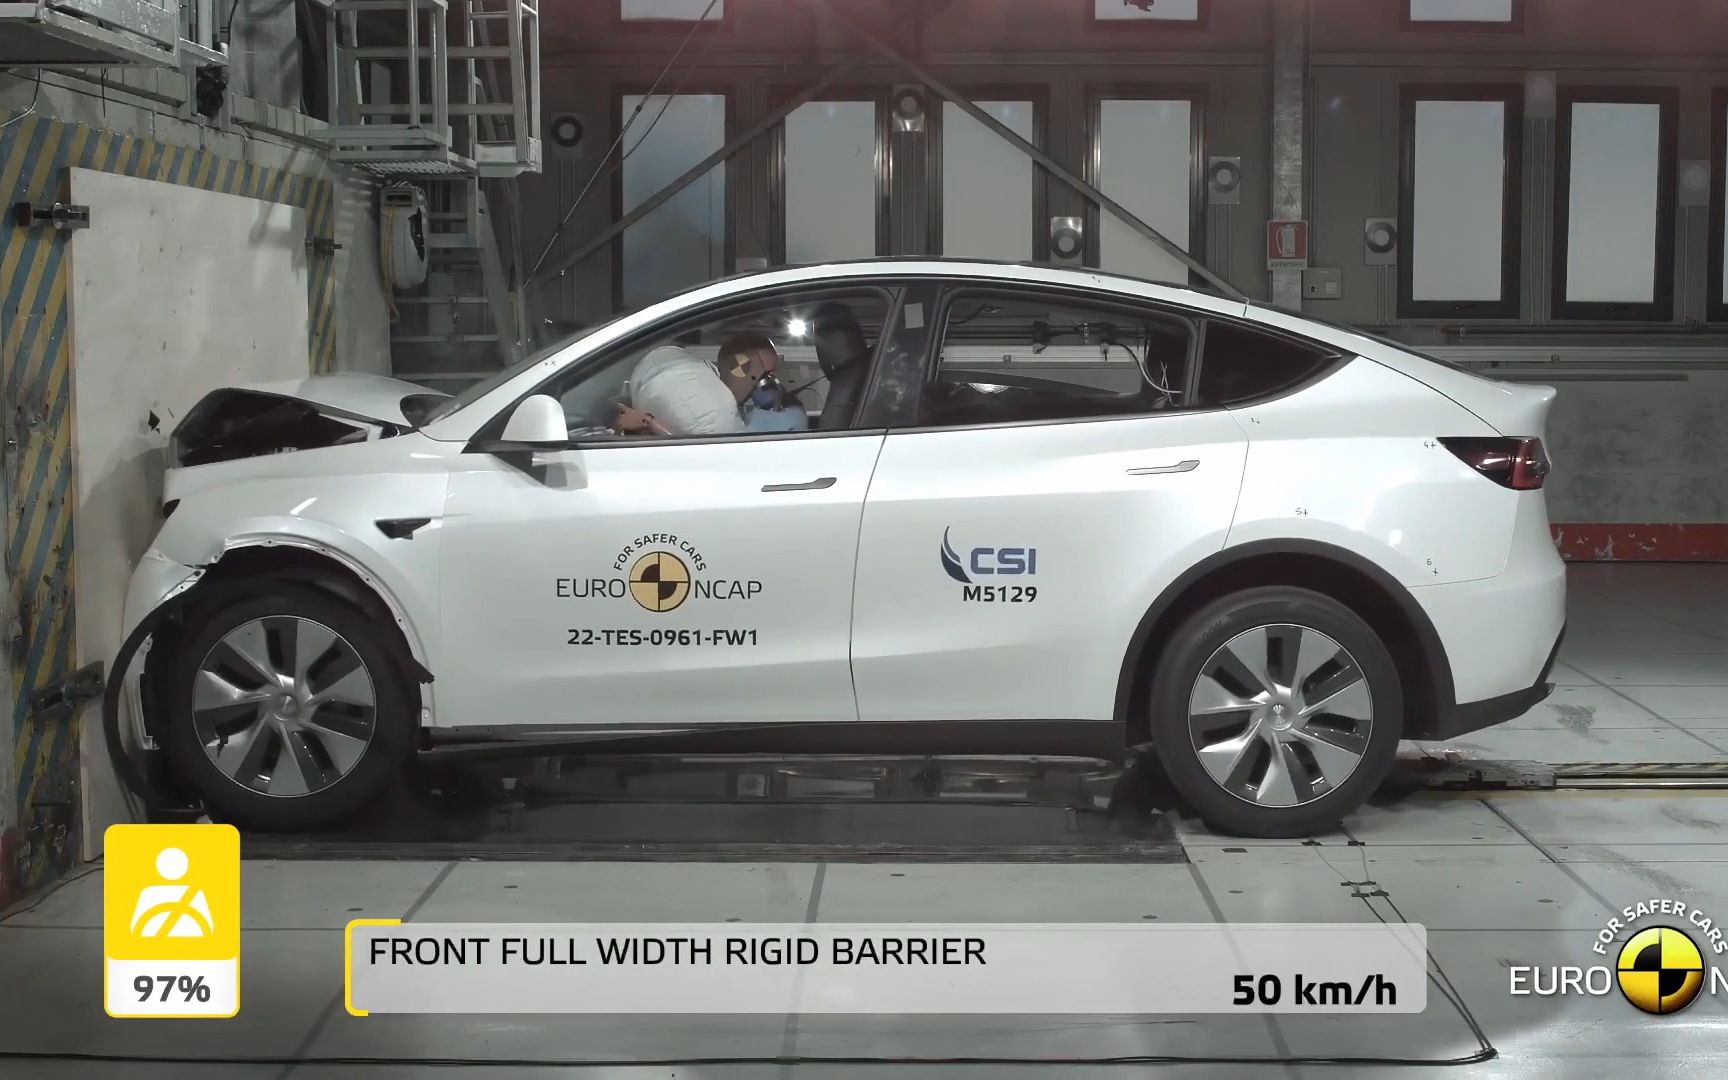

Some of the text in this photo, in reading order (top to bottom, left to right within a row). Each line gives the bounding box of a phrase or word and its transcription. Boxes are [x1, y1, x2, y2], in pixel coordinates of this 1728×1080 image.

[613, 533, 707, 571] FOR SAFER CARS
[970, 547, 1036, 575] CSI
[556, 578, 763, 600] EURO NCAP
[963, 585, 1038, 603] M5129
[567, 628, 758, 646] 22-TES-0961-FW1
